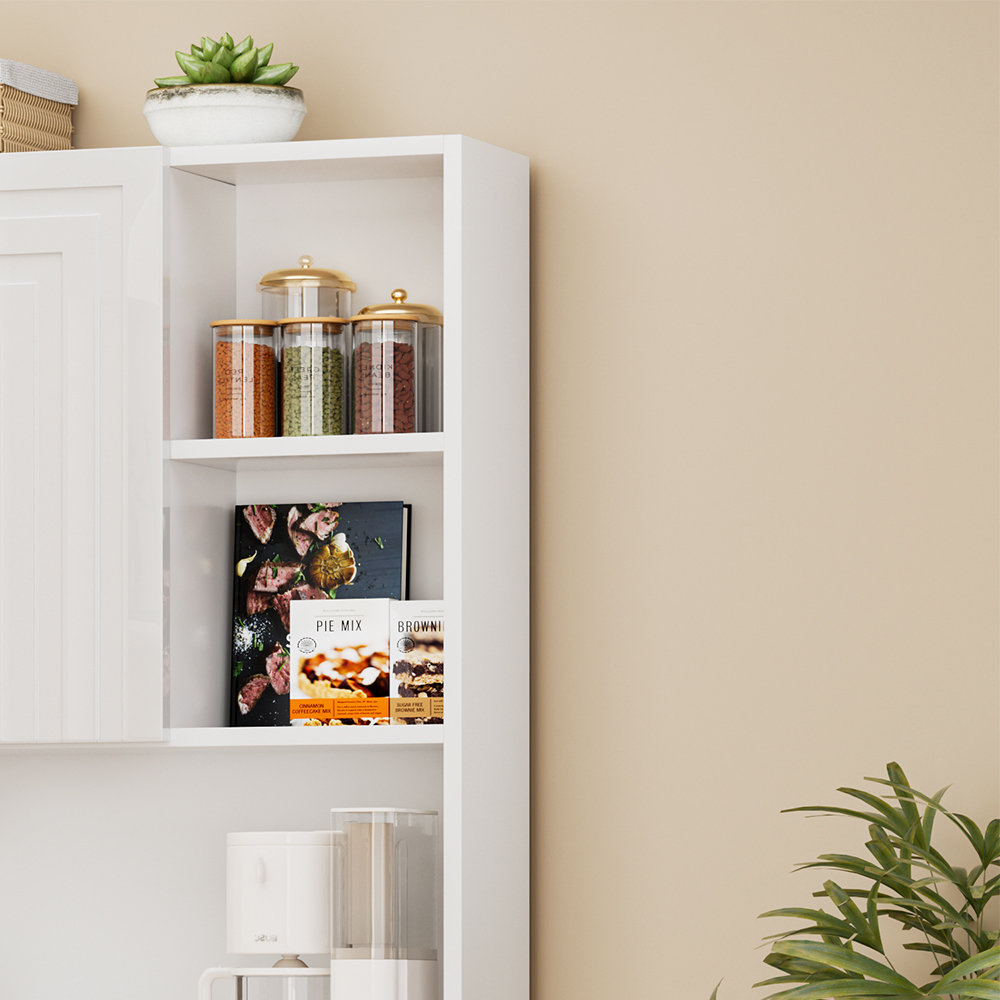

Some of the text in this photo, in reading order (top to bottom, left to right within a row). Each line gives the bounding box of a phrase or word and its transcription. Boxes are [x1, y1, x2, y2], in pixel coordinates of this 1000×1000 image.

[316, 619, 362, 632] PIE MIX
[398, 620, 444, 633] BROWNI
